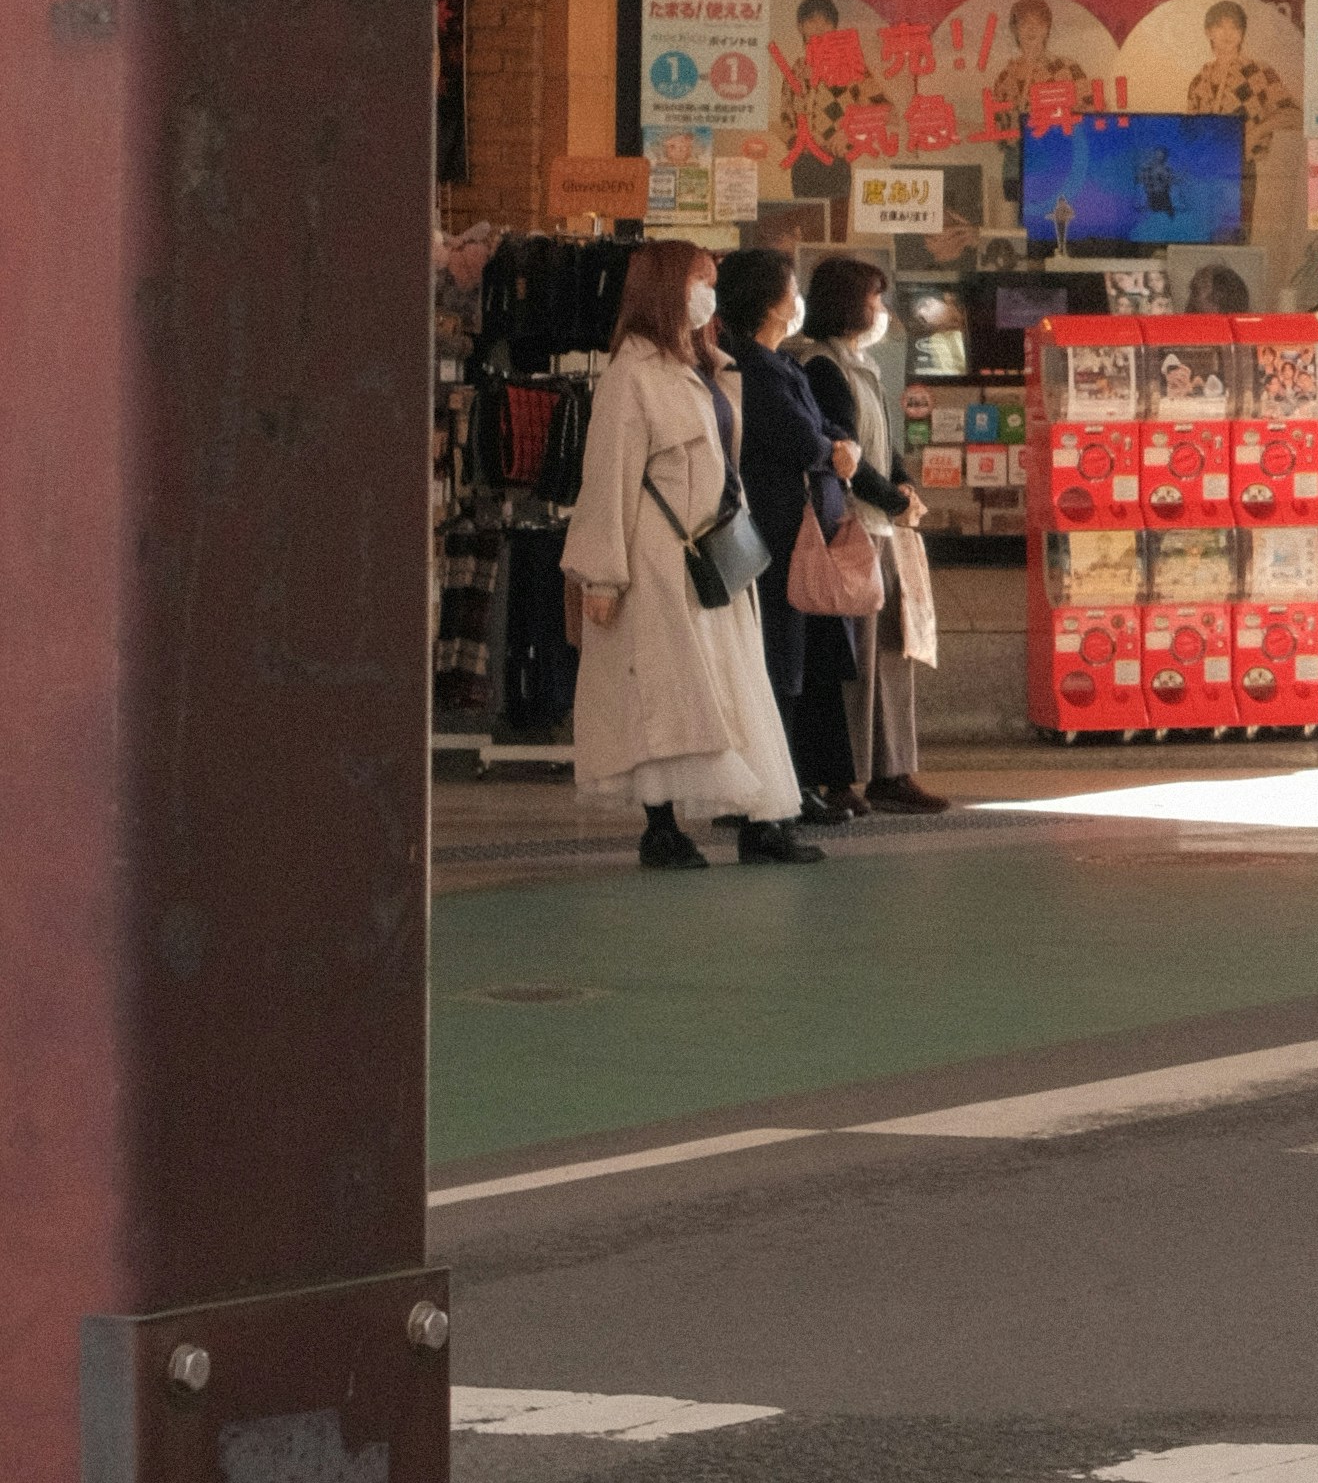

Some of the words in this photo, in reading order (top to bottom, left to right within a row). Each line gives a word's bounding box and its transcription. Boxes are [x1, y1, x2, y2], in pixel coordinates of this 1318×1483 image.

[780, 76, 1130, 169] 人気急上昇!!
[861, 178, 933, 207] 度あり
